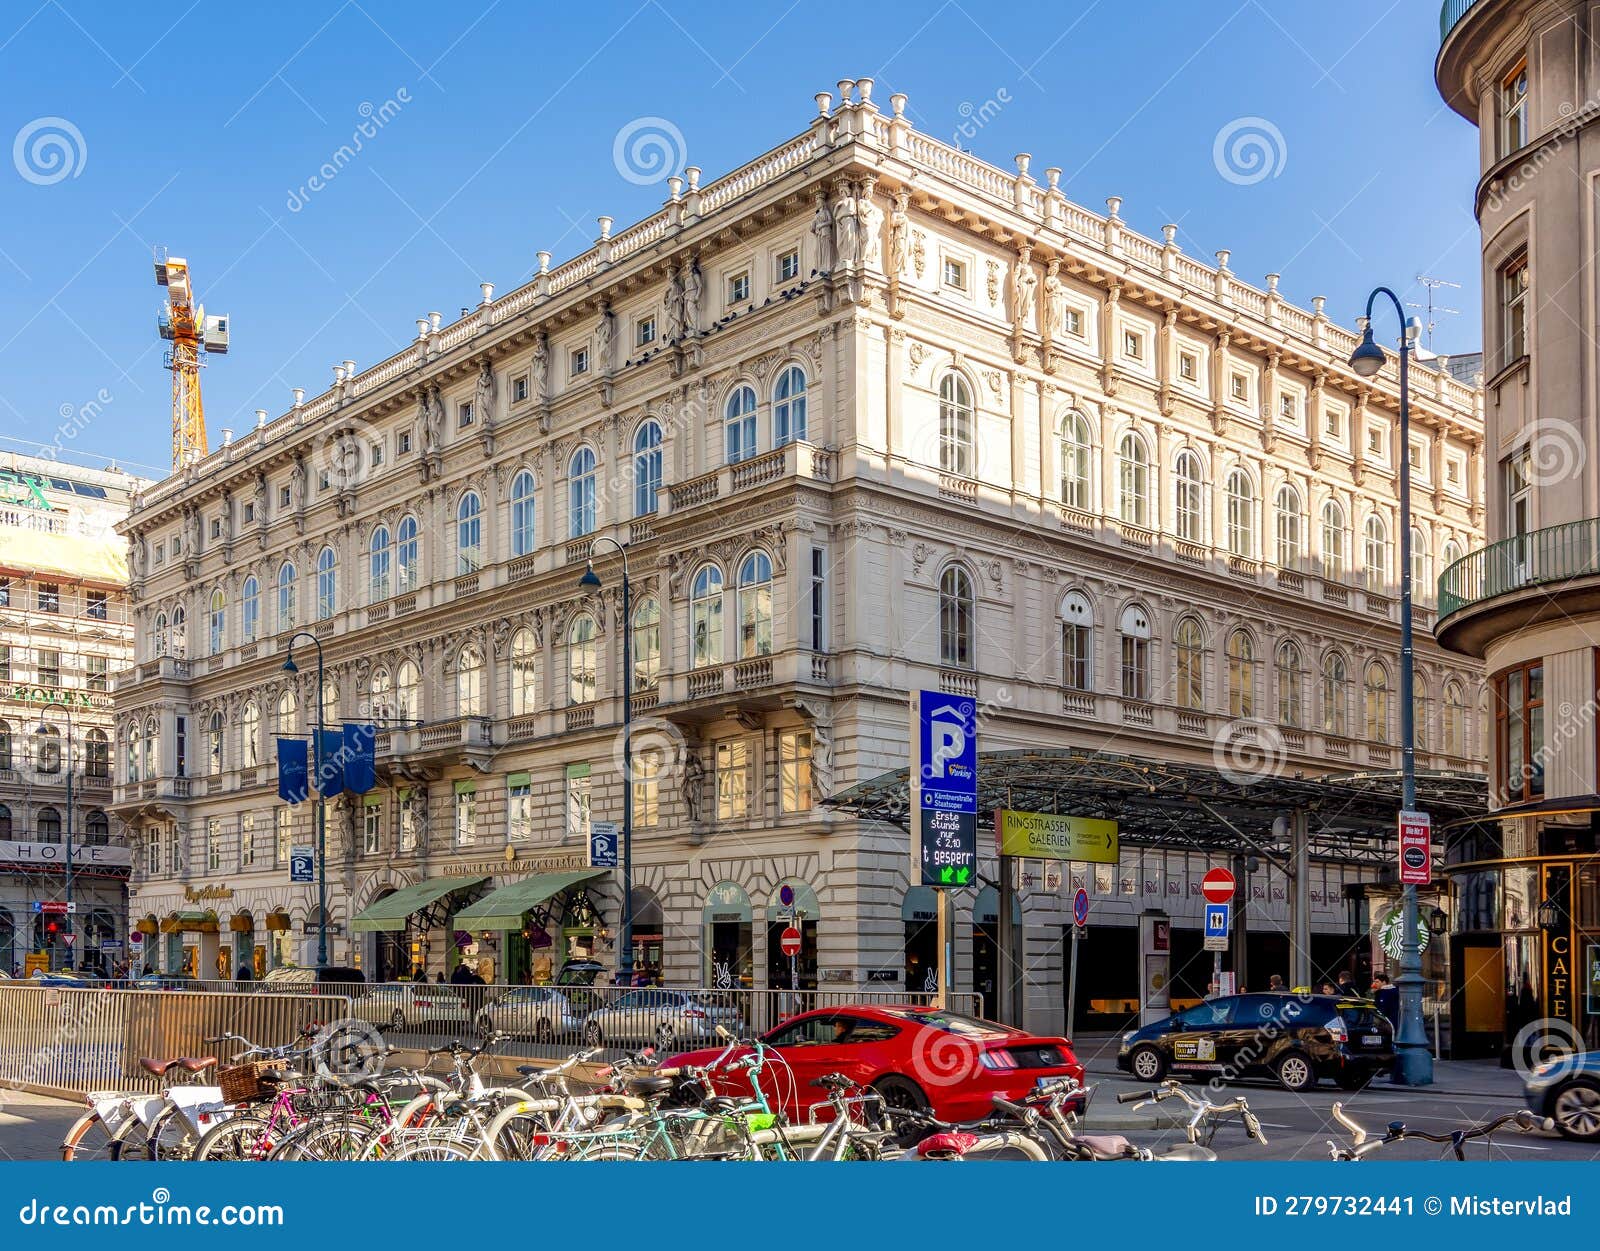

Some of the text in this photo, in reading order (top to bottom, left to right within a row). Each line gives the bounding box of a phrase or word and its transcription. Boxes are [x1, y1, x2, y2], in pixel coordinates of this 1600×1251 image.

[931, 720, 966, 778] P
[934, 800, 963, 809] Staatsoper
[935, 811, 960, 822] Erste
[931, 819, 960, 831] Stunde
[1007, 815, 1071, 833] RINGSTRASSEN
[940, 831, 955, 839] nur
[1028, 832, 1071, 847] GALERIEN
[1552, 936, 1568, 1017] CAFE
